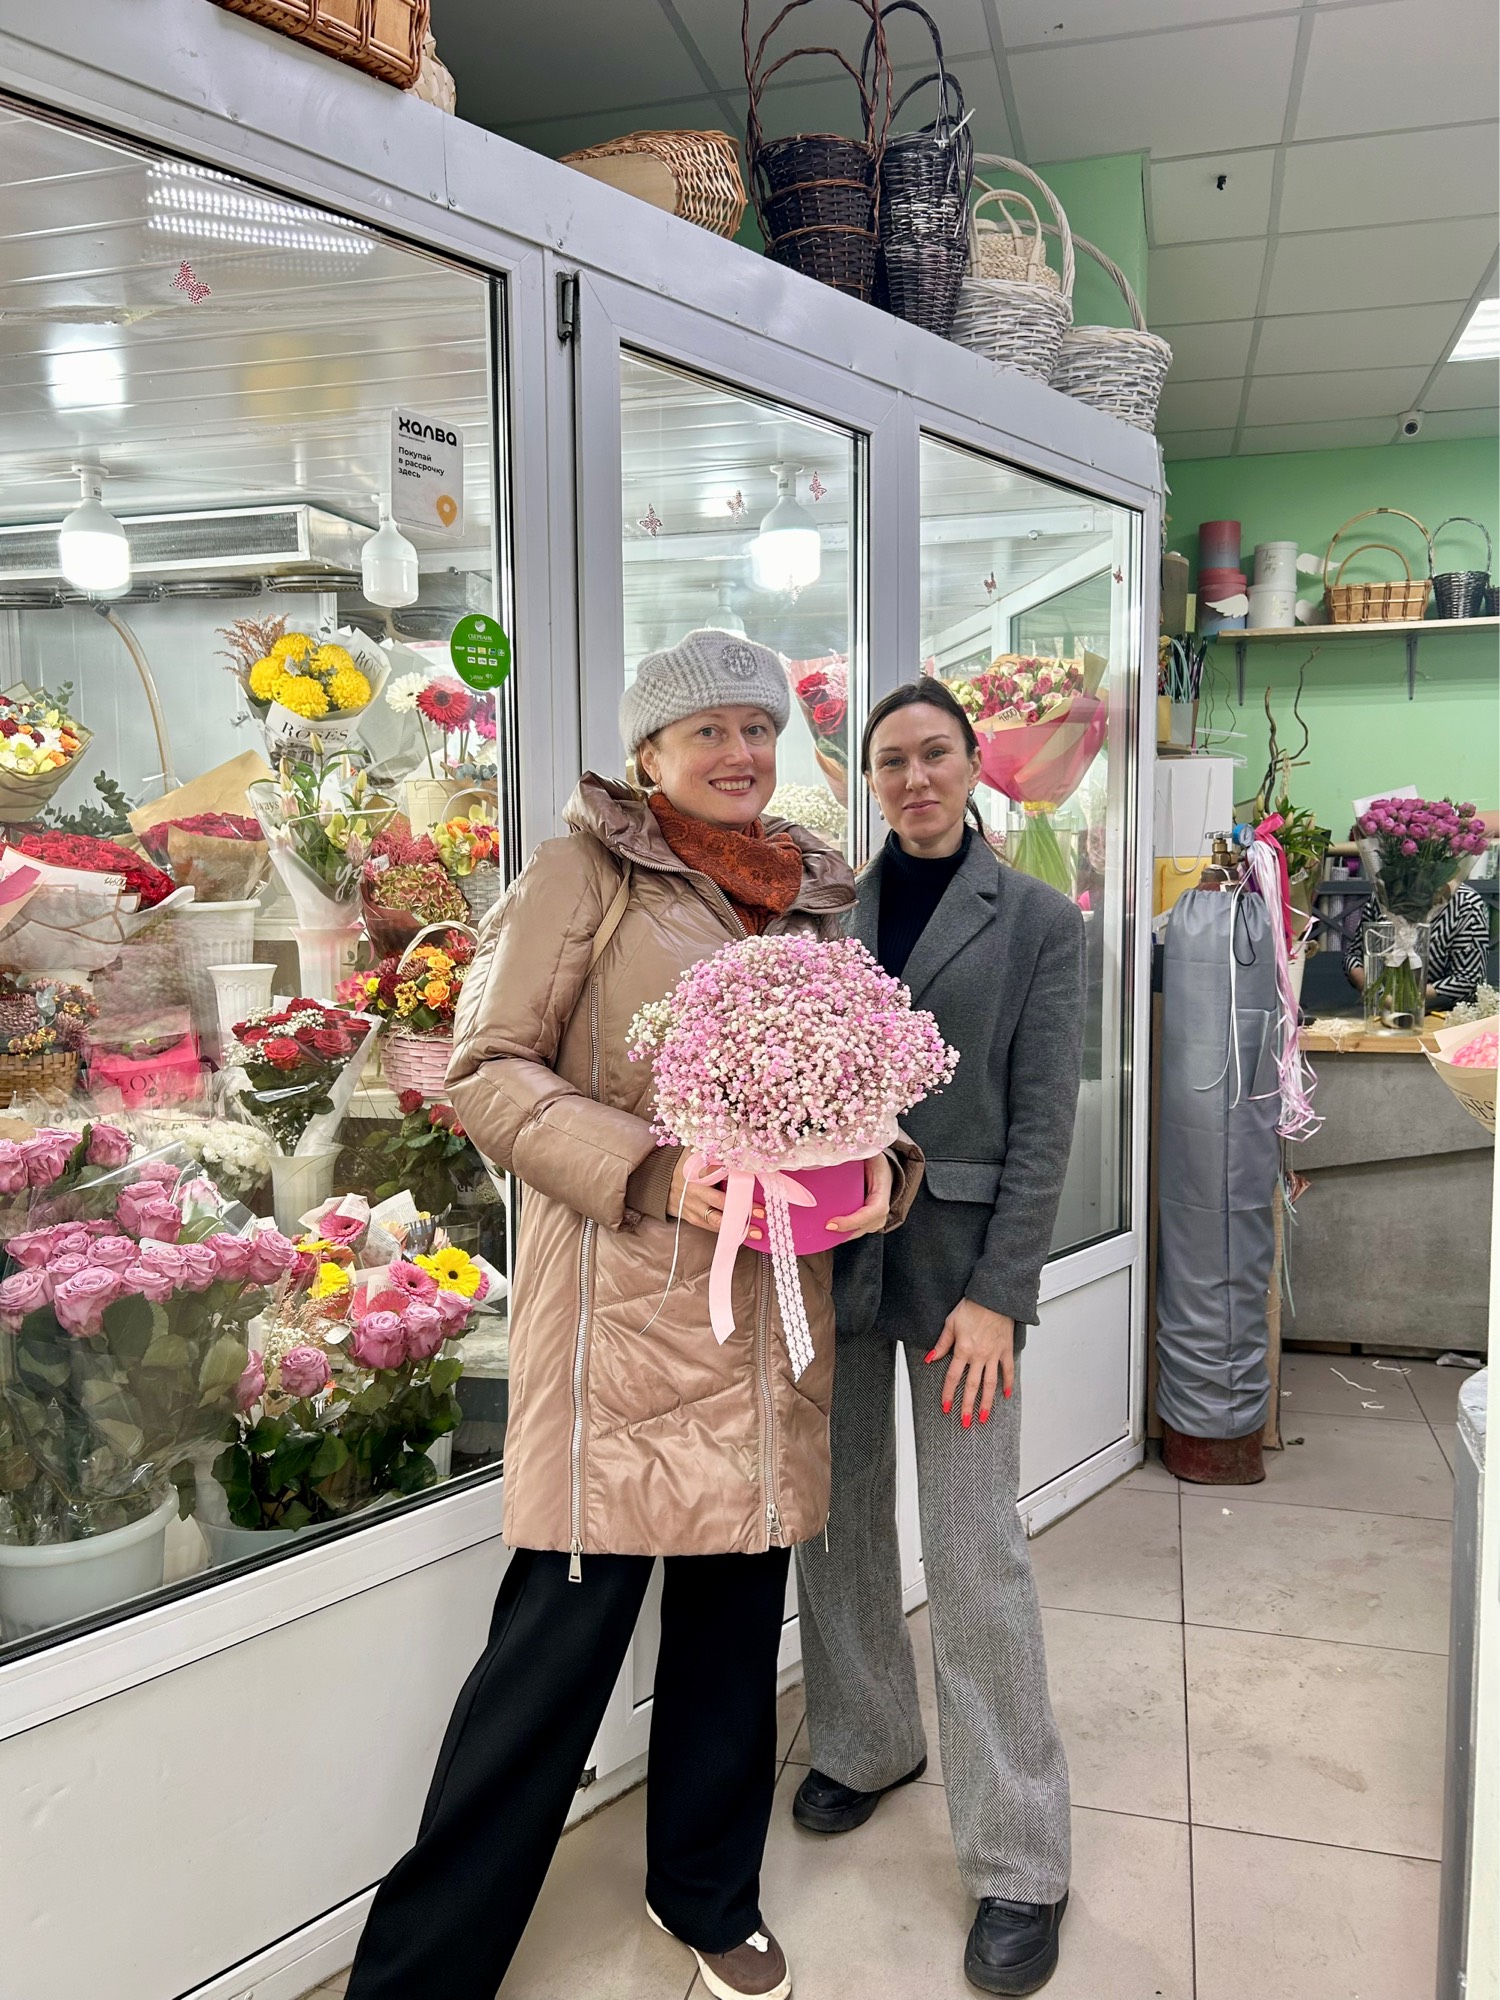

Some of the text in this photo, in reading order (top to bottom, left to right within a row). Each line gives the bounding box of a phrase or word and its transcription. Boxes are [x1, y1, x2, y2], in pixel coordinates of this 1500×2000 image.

[398, 446, 432, 462] Покупай
[398, 467, 421, 479] здесь
[404, 459, 445, 477] рассрочку
